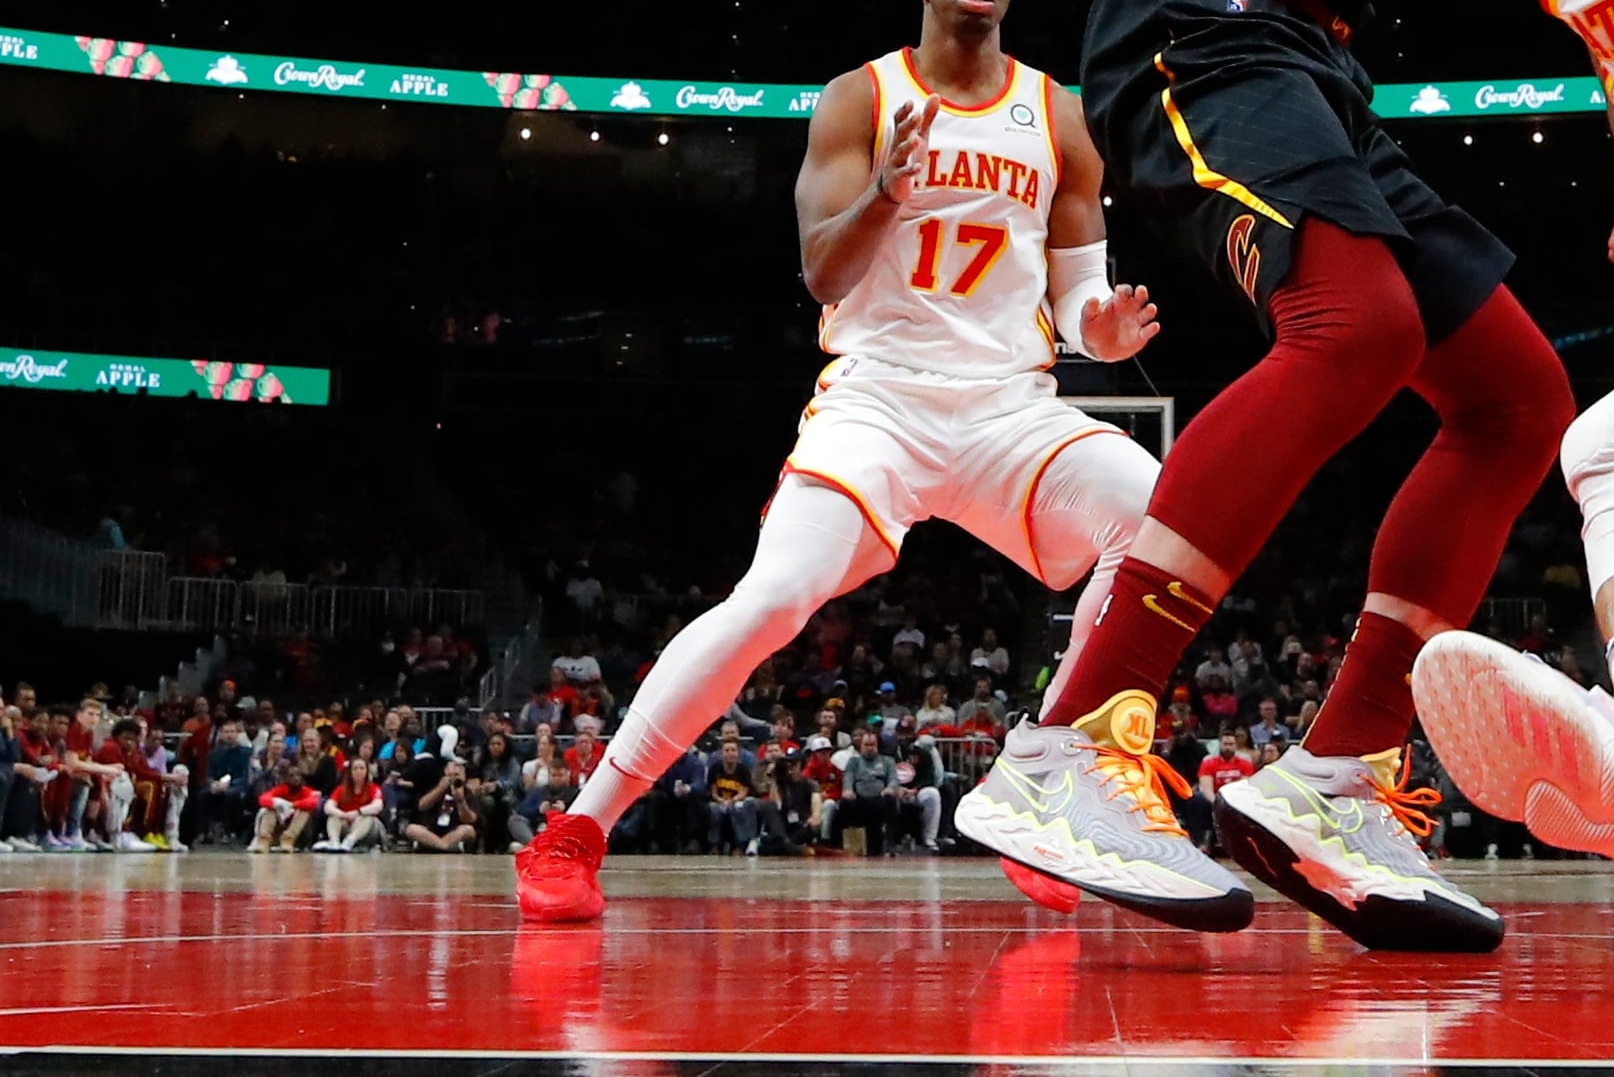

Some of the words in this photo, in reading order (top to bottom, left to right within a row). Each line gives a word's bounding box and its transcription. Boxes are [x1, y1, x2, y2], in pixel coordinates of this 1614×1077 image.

[0, 42, 38, 60] PLE
[389, 79, 449, 97] APPLE
[925, 148, 1040, 210] LANTA
[908, 216, 1010, 298] 17
[95, 370, 161, 388] APPLE
